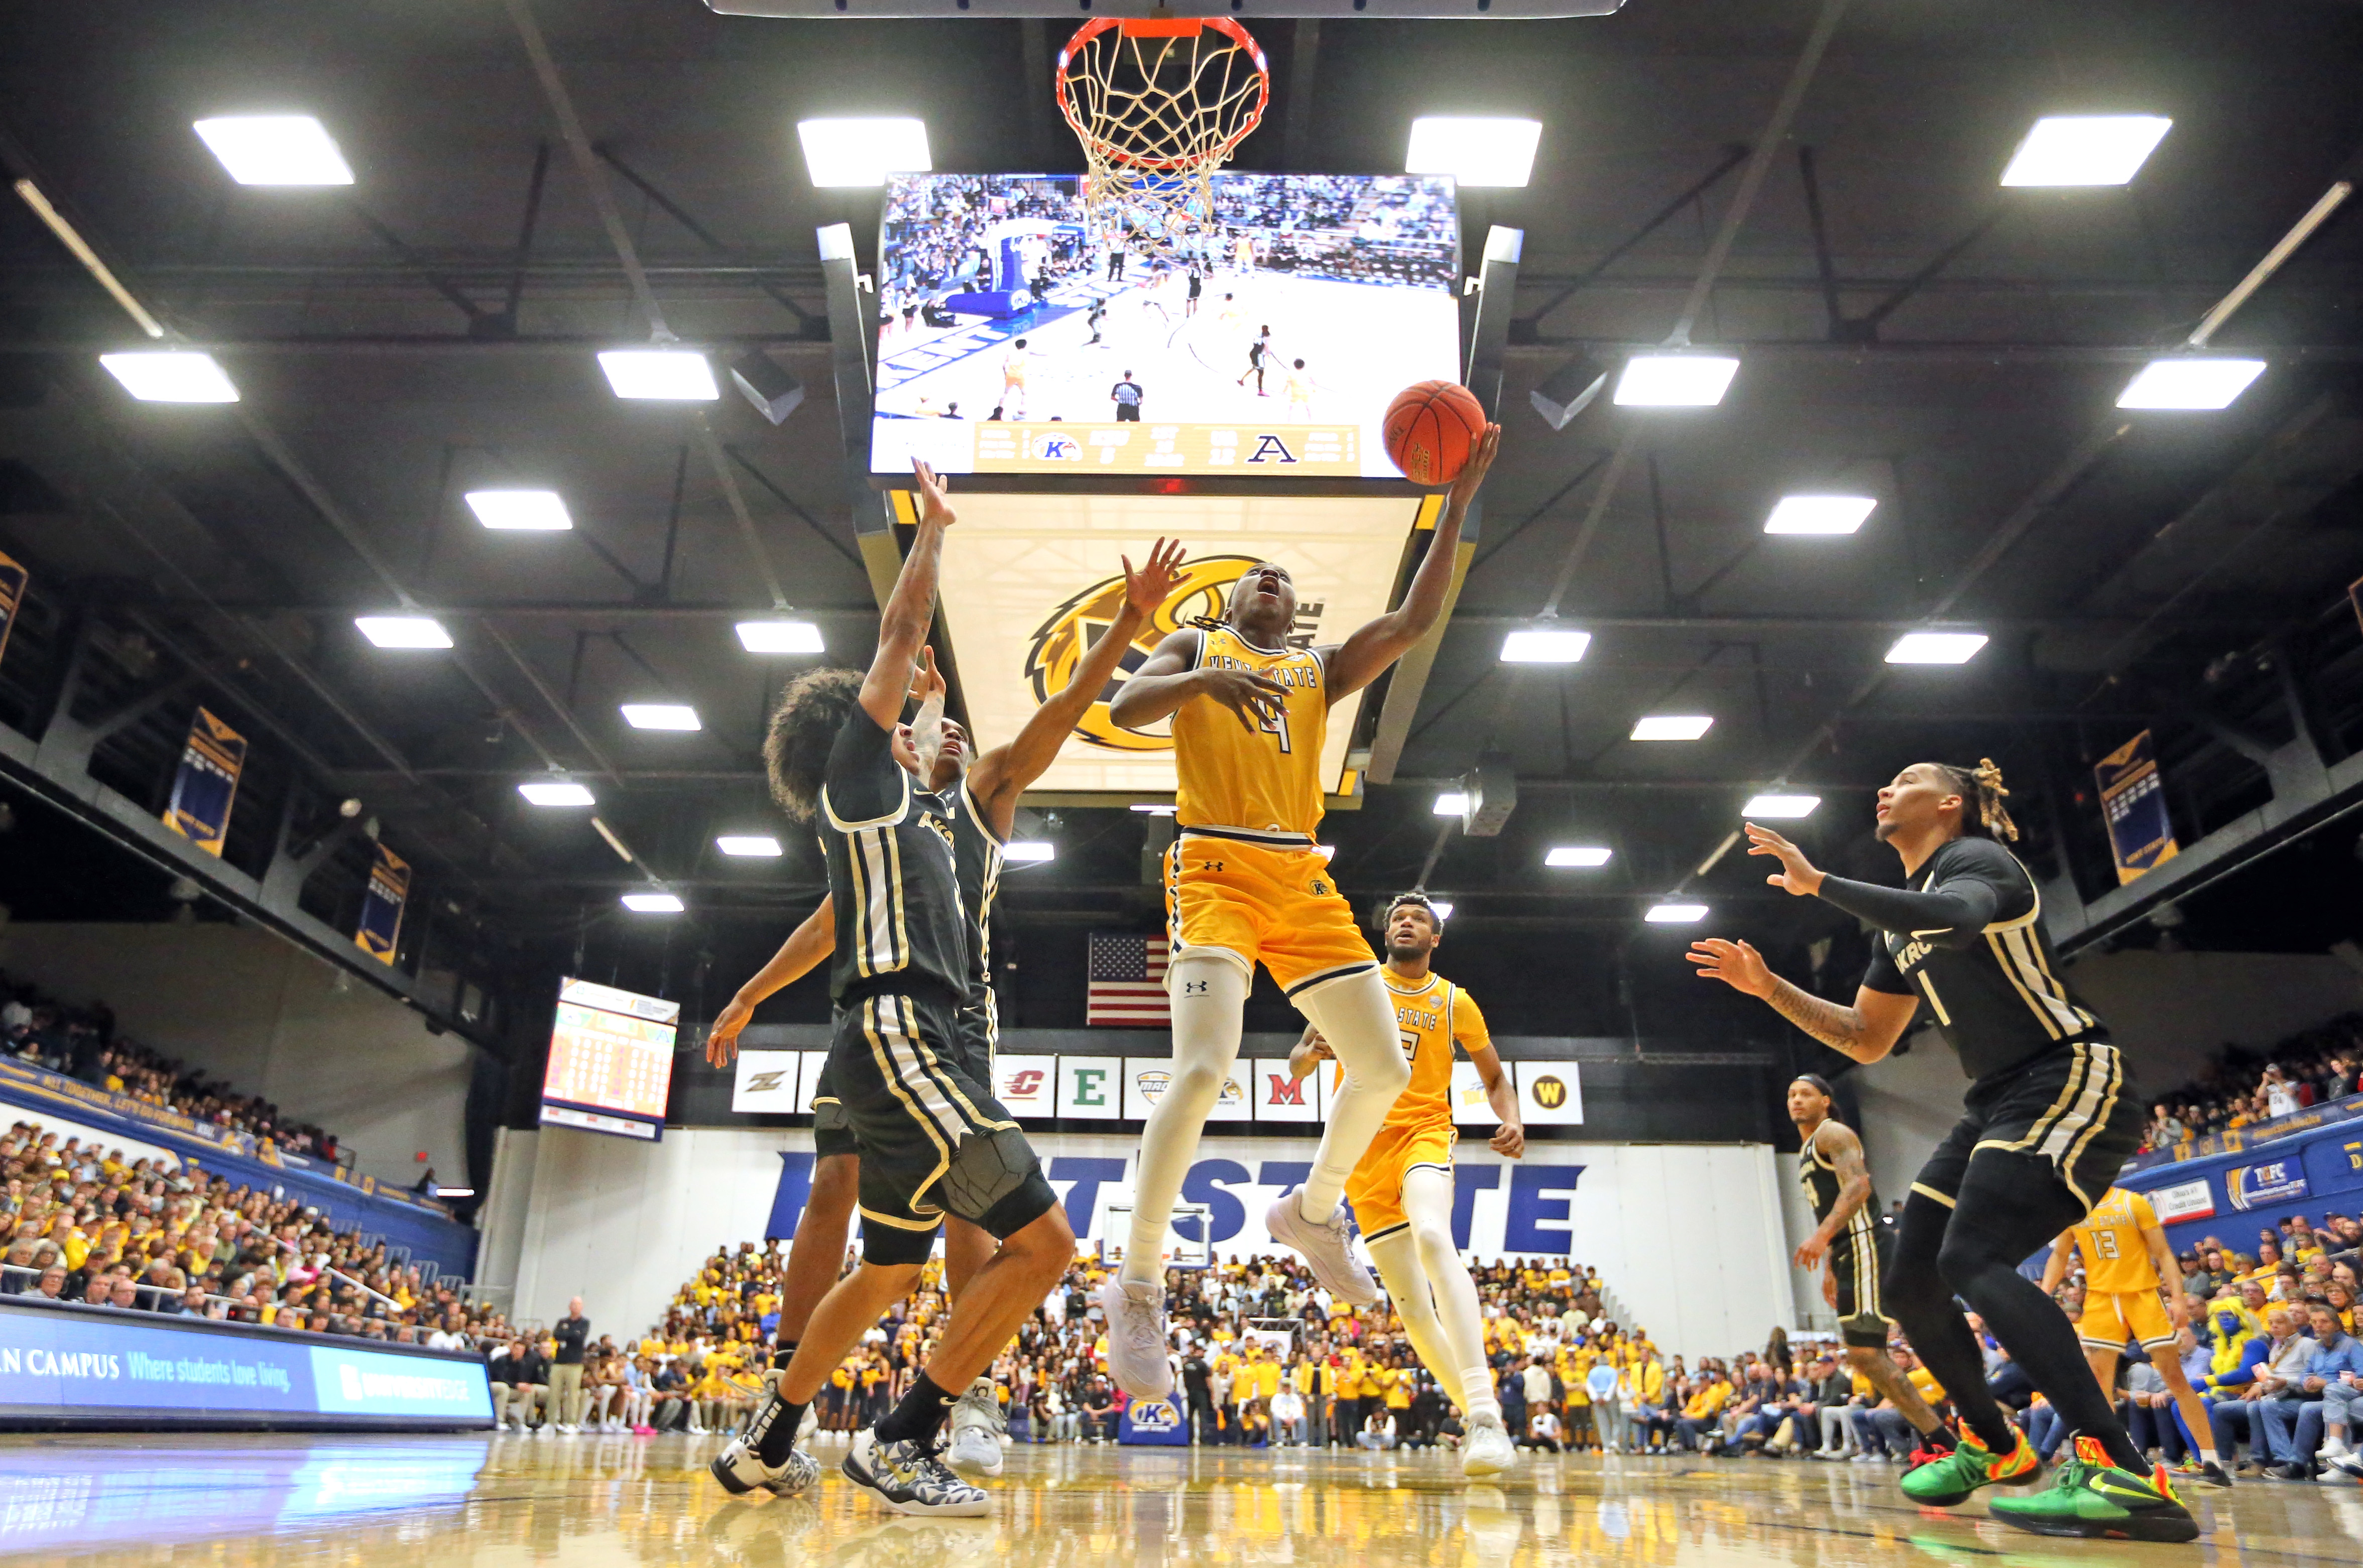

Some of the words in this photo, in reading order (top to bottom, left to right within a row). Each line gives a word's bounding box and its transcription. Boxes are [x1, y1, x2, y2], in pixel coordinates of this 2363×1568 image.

[1044, 442, 1066, 457] K
[1247, 436, 1297, 462] A
[1259, 667, 1317, 688] TATE
[1255, 695, 1291, 754] 4
[1397, 1007, 1437, 1031] STATE
[744, 1070, 788, 1092] Z
[1073, 1069, 1106, 1106] E
[1268, 1074, 1307, 1105] M
[1535, 1082, 1562, 1105] W
[1170, 1158, 1587, 1254] STTE
[2090, 1230, 2120, 1260] 13
[0, 1348, 21, 1373] N
[27, 1349, 120, 1380] CAMPUS
[126, 1350, 175, 1381] Where
[176, 1357, 231, 1383] students
[231, 1360, 257, 1386] love
[1143, 1404, 1166, 1422] K
